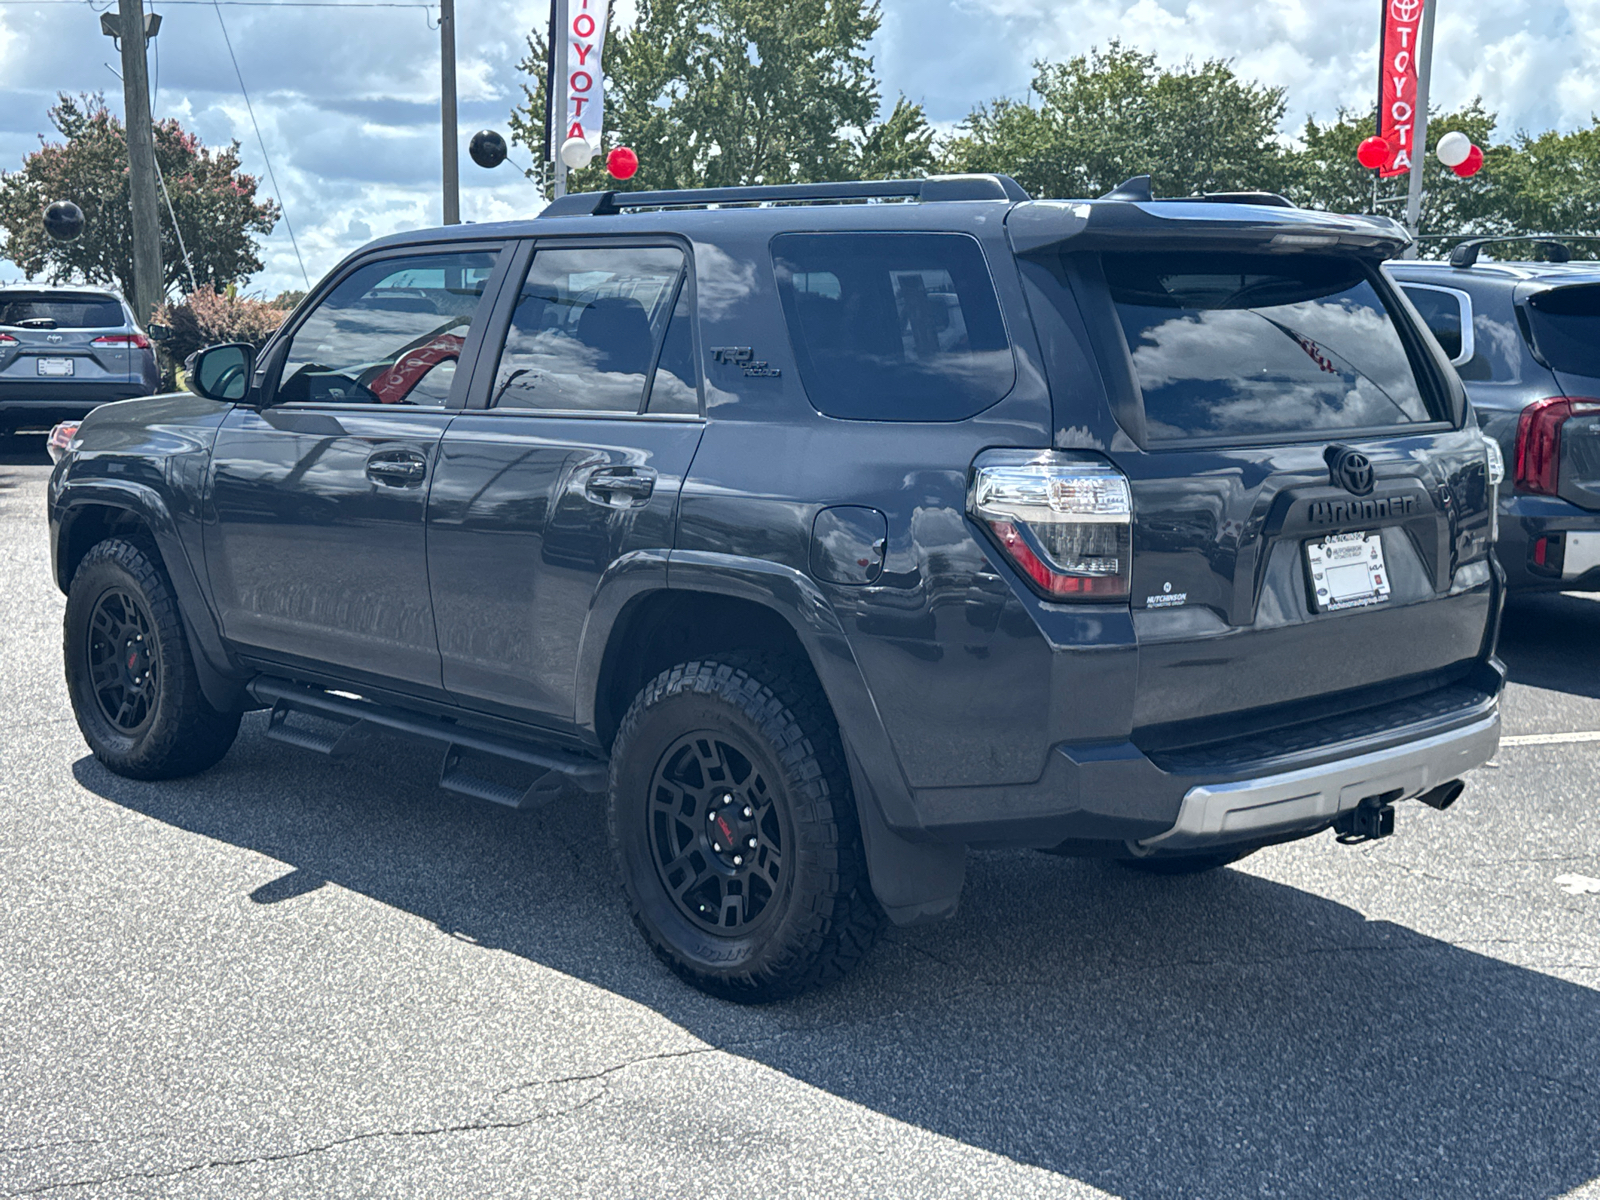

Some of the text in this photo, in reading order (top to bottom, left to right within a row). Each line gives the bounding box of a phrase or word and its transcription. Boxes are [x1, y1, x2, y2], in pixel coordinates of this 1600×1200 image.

[1391, 27, 1412, 170] TOYOTA
[710, 346, 752, 364] TRD
[740, 361, 767, 369] OFF
[743, 368, 780, 377] ROAD
[1147, 593, 1187, 603] HUTCHINSON
